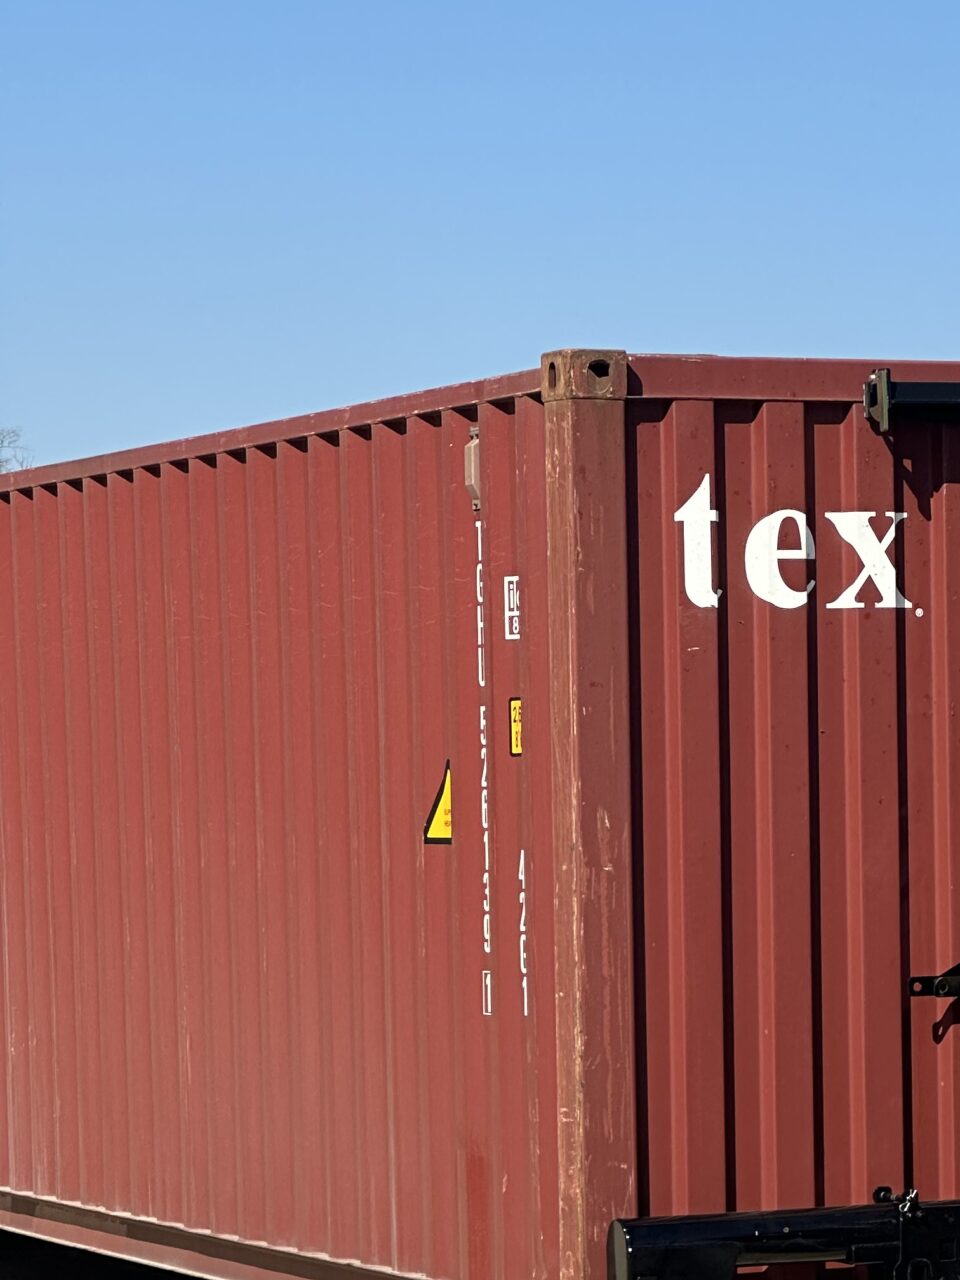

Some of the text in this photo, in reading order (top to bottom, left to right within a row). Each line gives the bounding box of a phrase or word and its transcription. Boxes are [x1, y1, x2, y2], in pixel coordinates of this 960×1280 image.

[475, 520, 486, 687] TGHU
[673, 472, 913, 609] tex
[518, 849, 528, 1016] 42G1
